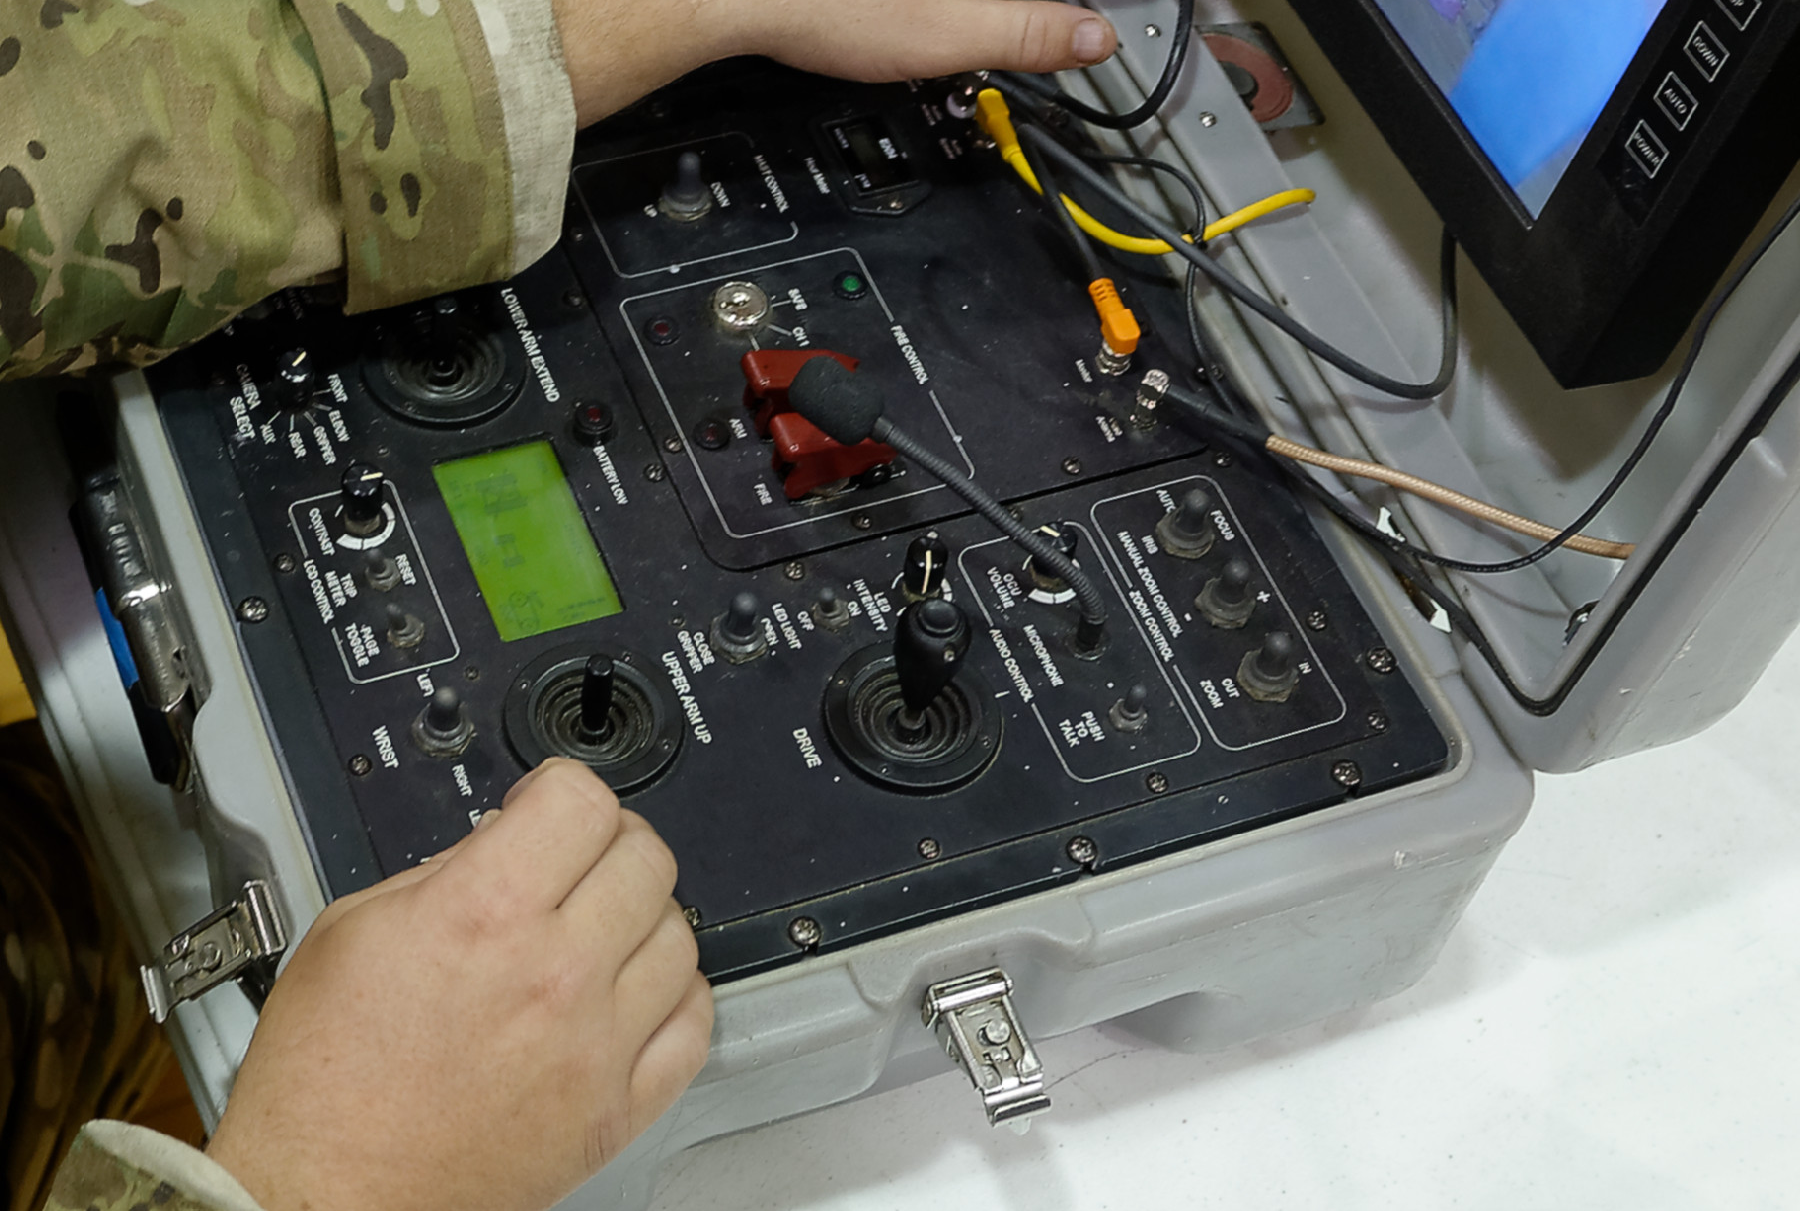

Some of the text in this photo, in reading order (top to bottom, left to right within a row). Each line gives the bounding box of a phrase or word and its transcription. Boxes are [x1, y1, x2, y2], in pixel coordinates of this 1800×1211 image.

[1691, 35, 1719, 67] DOWN
[1663, 87, 1688, 115] AUTO
[1633, 131, 1661, 166] POWER
[710, 181, 731, 208] DOWN
[764, 175, 790, 213] CONTROL
[643, 204, 658, 218] UP
[501, 288, 560, 403] LOWER ARM EXTEND
[891, 325, 929, 385] FIRE CONTROL
[236, 363, 262, 411] CAMERA
[327, 373, 349, 404] FRONT
[230, 396, 256, 439] SELECT
[259, 423, 277, 445] AUX
[328, 410, 351, 443] ELBOW
[729, 417, 748, 439] ARM
[288, 432, 307, 460] REAR
[313, 425, 337, 466] GRIPPER
[593, 444, 629, 506] BATTERY LOW
[753, 483, 774, 506] FIRE
[309, 507, 336, 557] CONTRAST
[1210, 509, 1235, 541] FOCUS
[1141, 535, 1159, 555] IRIS
[340, 573, 358, 598] TRIP
[395, 553, 417, 586] RESET
[1002, 573, 1022, 596] OCU
[1117, 530, 1183, 639] MANUAL ZOOM CONTROL
[303, 559, 335, 625] LCD CONTROL
[325, 570, 347, 608] METER
[873, 591, 891, 613] LED
[987, 566, 1015, 609] VOLUME
[797, 610, 815, 631] OFF
[847, 600, 862, 617] ON
[852, 578, 888, 631] INTENSITY
[360, 626, 380, 658] PAGE
[772, 602, 802, 649] LED LIGHT
[1129, 590, 1175, 662] ZOOM CONTROL
[345, 622, 370, 668] TOGGLE
[677, 630, 703, 674] GRIPPER
[693, 631, 715, 666] CLOSE
[1023, 624, 1064, 687] MICROPHONE
[989, 629, 1034, 703] AUDIO CONTROL
[1298, 661, 1312, 675] IN
[661, 651, 713, 744] UPPER ARM UP
[1200, 680, 1224, 709] ZOOM
[1221, 677, 1240, 699] OUT
[1059, 719, 1080, 748] TALK
[1074, 721, 1089, 738] TO
[1081, 711, 1105, 742] PUSH
[372, 725, 399, 769] WRIST
[793, 727, 823, 769] DRIVE
[452, 764, 473, 797] RIGHT
